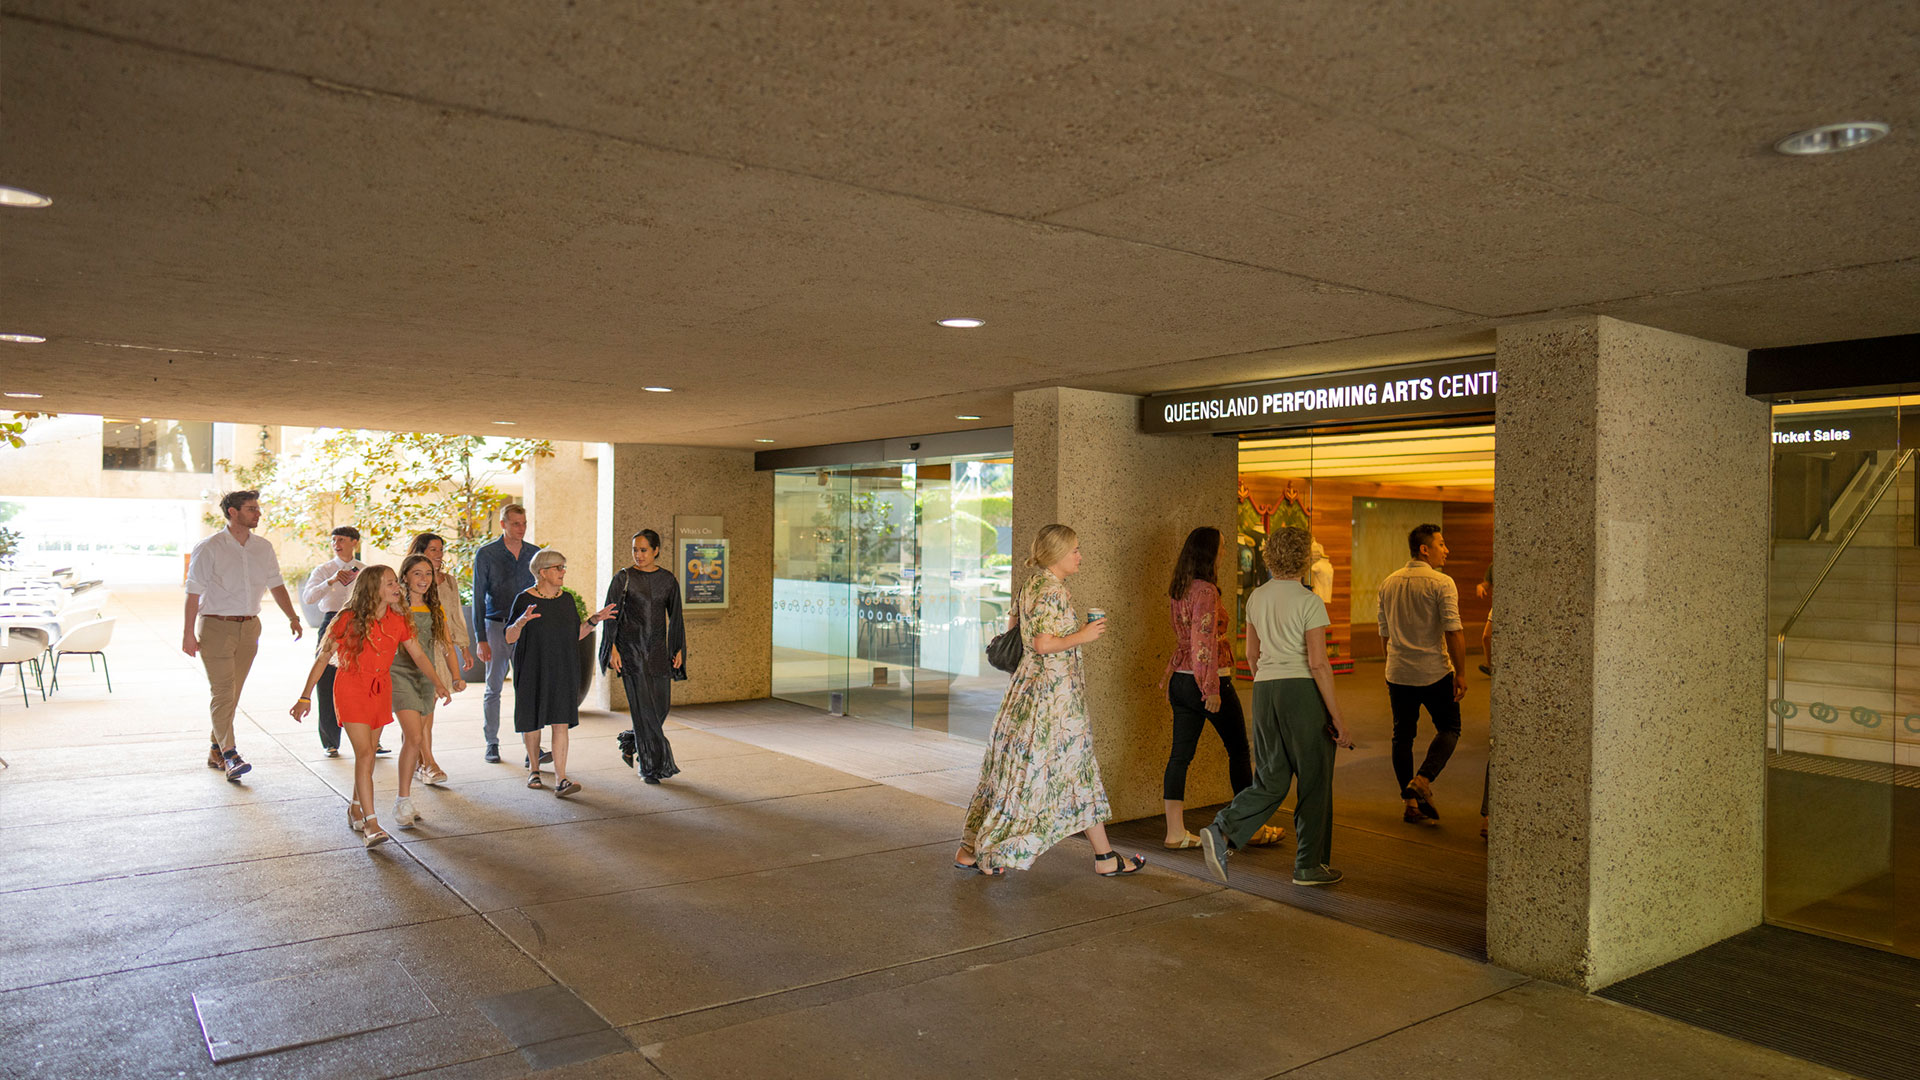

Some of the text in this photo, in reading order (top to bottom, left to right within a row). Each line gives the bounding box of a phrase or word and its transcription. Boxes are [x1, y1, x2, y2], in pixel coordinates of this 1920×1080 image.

[1164, 396, 1259, 423] QUEENSLAND
[1262, 384, 1377, 414] PERFORMING
[1381, 378, 1433, 404] ARTS
[1771, 428, 1851, 444] Ticket Sales
[687, 559, 702, 579] 9
[709, 560, 723, 579] 5
